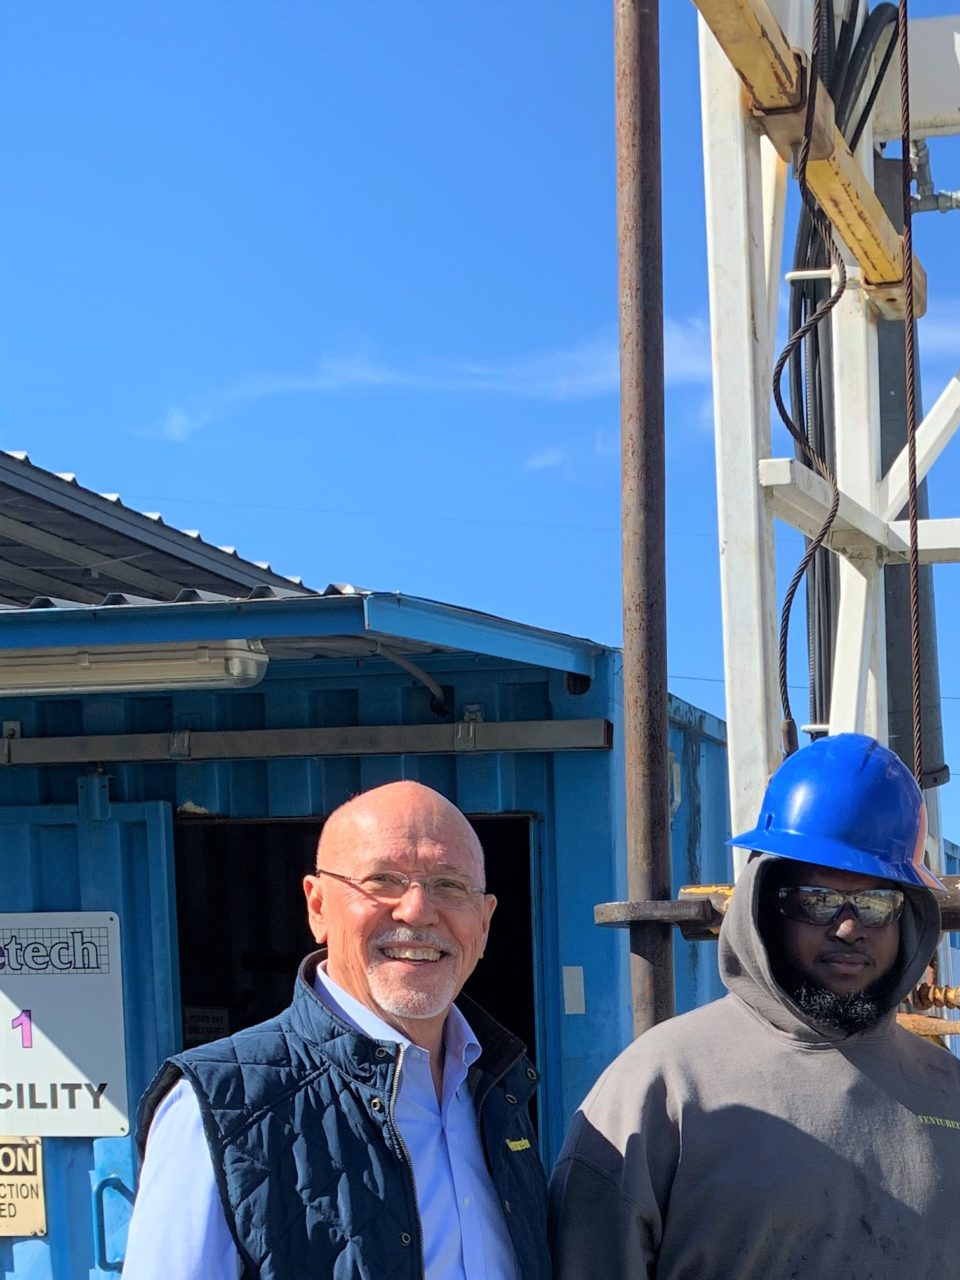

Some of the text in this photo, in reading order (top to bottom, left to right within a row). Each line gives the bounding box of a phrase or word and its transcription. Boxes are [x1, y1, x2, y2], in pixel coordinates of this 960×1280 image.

[0, 931, 100, 970] tech
[11, 1009, 33, 1048] 1
[0, 1147, 34, 1172] ON
[0, 1202, 17, 1217] ED
